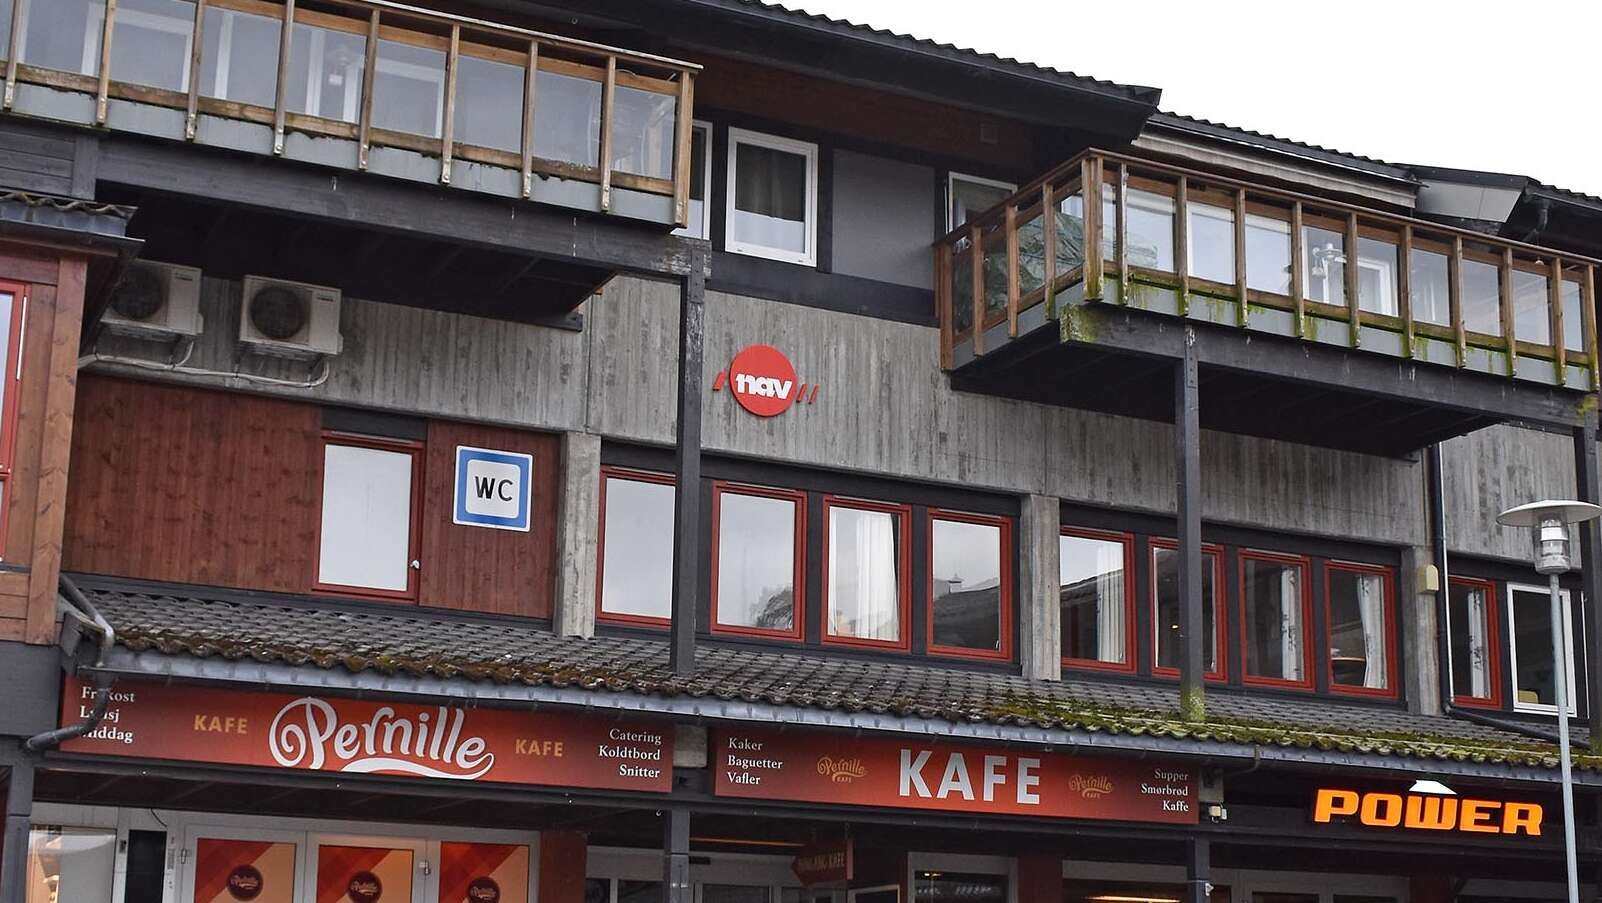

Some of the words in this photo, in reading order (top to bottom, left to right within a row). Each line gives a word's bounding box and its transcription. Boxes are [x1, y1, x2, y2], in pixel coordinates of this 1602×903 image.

[736, 374, 792, 400] nav
[475, 476, 513, 502] WC
[81, 686, 135, 703] Frkost
[80, 705, 120, 723] Lsj
[194, 714, 248, 734] KAFE
[83, 726, 133, 744] iddag
[269, 697, 494, 780] Pernille
[609, 728, 662, 745] Catering
[515, 738, 564, 758] KAFE
[728, 737, 763, 751] Kaker
[599, 745, 661, 761] Koldtbord
[619, 764, 660, 778] Snitter
[727, 755, 783, 770] Baguetter
[817, 756, 866, 778] Pernille
[727, 772, 761, 785] Vafler
[899, 749, 1041, 805] KAFE
[1154, 768, 1189, 782] Supper
[1141, 783, 1189, 797] Smørbrød
[1163, 800, 1189, 812] Kaffe
[1314, 789, 1543, 836] POWER
